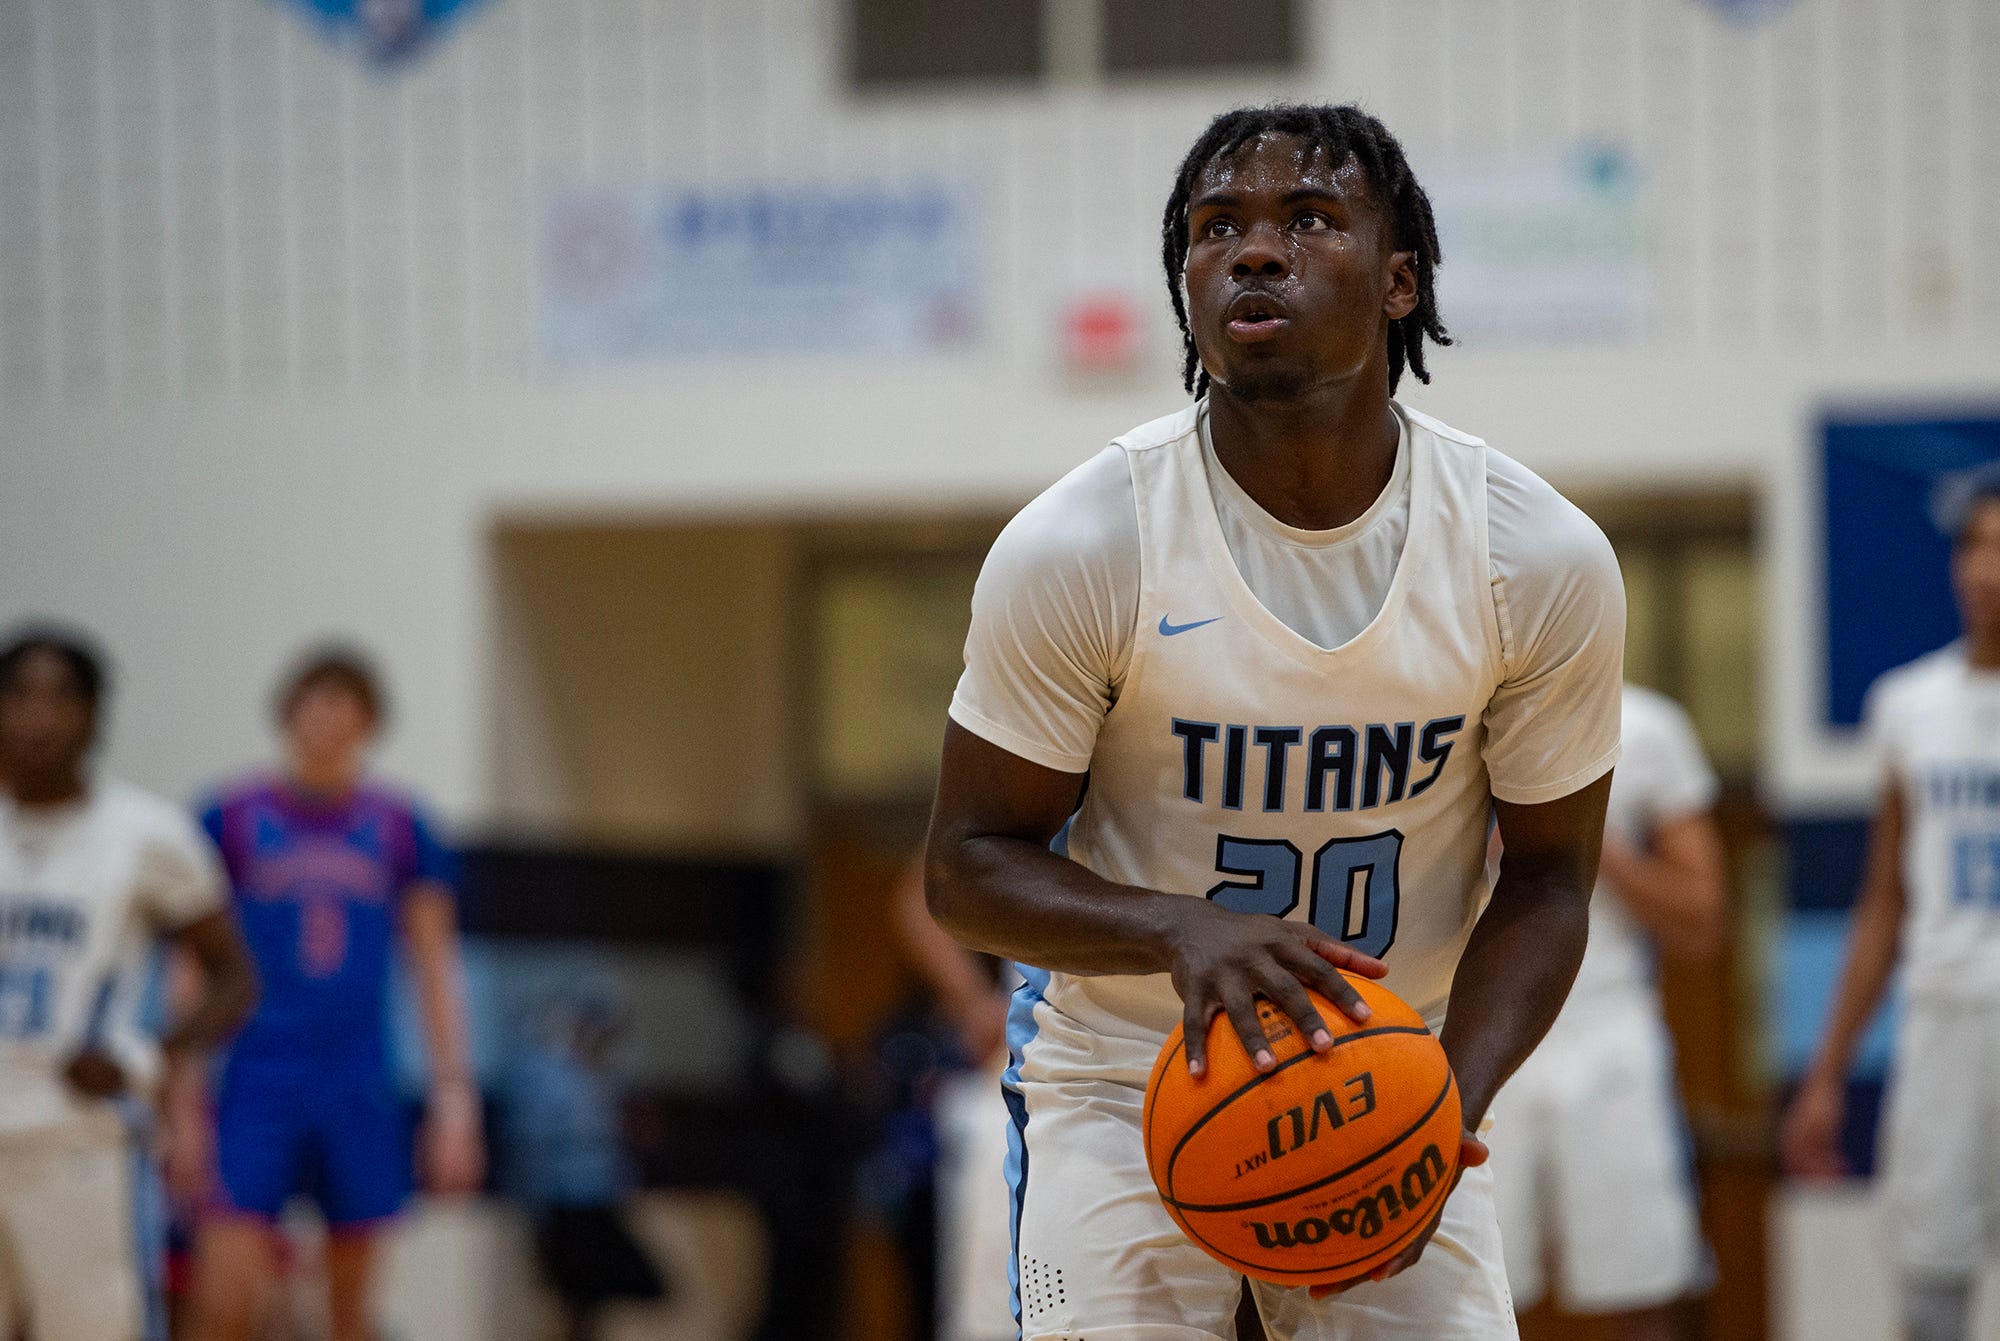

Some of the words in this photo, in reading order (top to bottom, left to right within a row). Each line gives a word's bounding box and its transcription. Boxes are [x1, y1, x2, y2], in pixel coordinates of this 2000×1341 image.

[1171, 714, 1466, 813] TITANS
[1206, 828, 1405, 960] 20
[1267, 1071, 1377, 1159] EVO
[1234, 1152, 1268, 1179] NXT
[1252, 1143, 1448, 1248] Wilson
